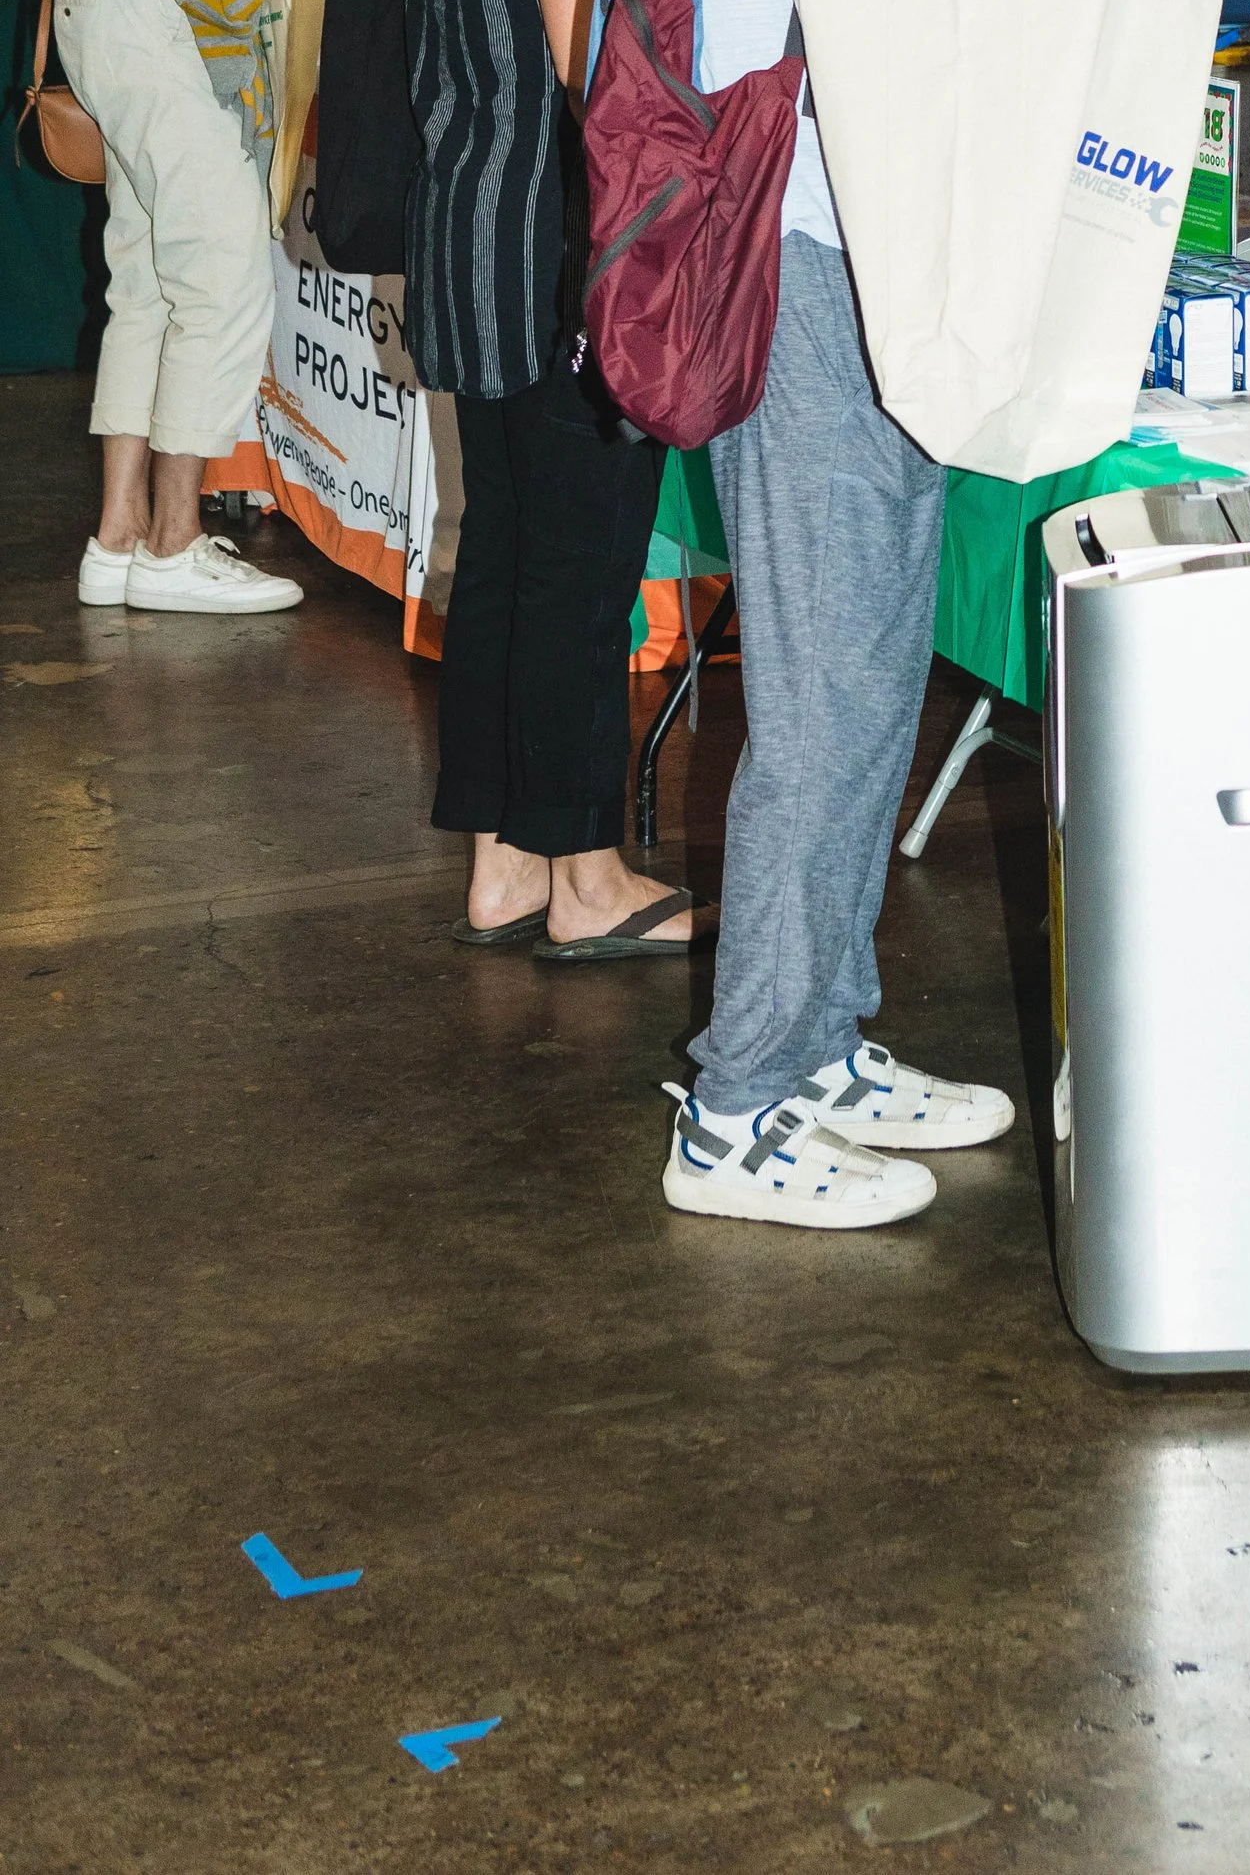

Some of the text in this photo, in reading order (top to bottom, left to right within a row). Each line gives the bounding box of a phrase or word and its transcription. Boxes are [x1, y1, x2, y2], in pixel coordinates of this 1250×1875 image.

[1077, 130, 1174, 193] GLOW
[297, 260, 407, 352] ENERGY
[351, 480, 390, 516] One
